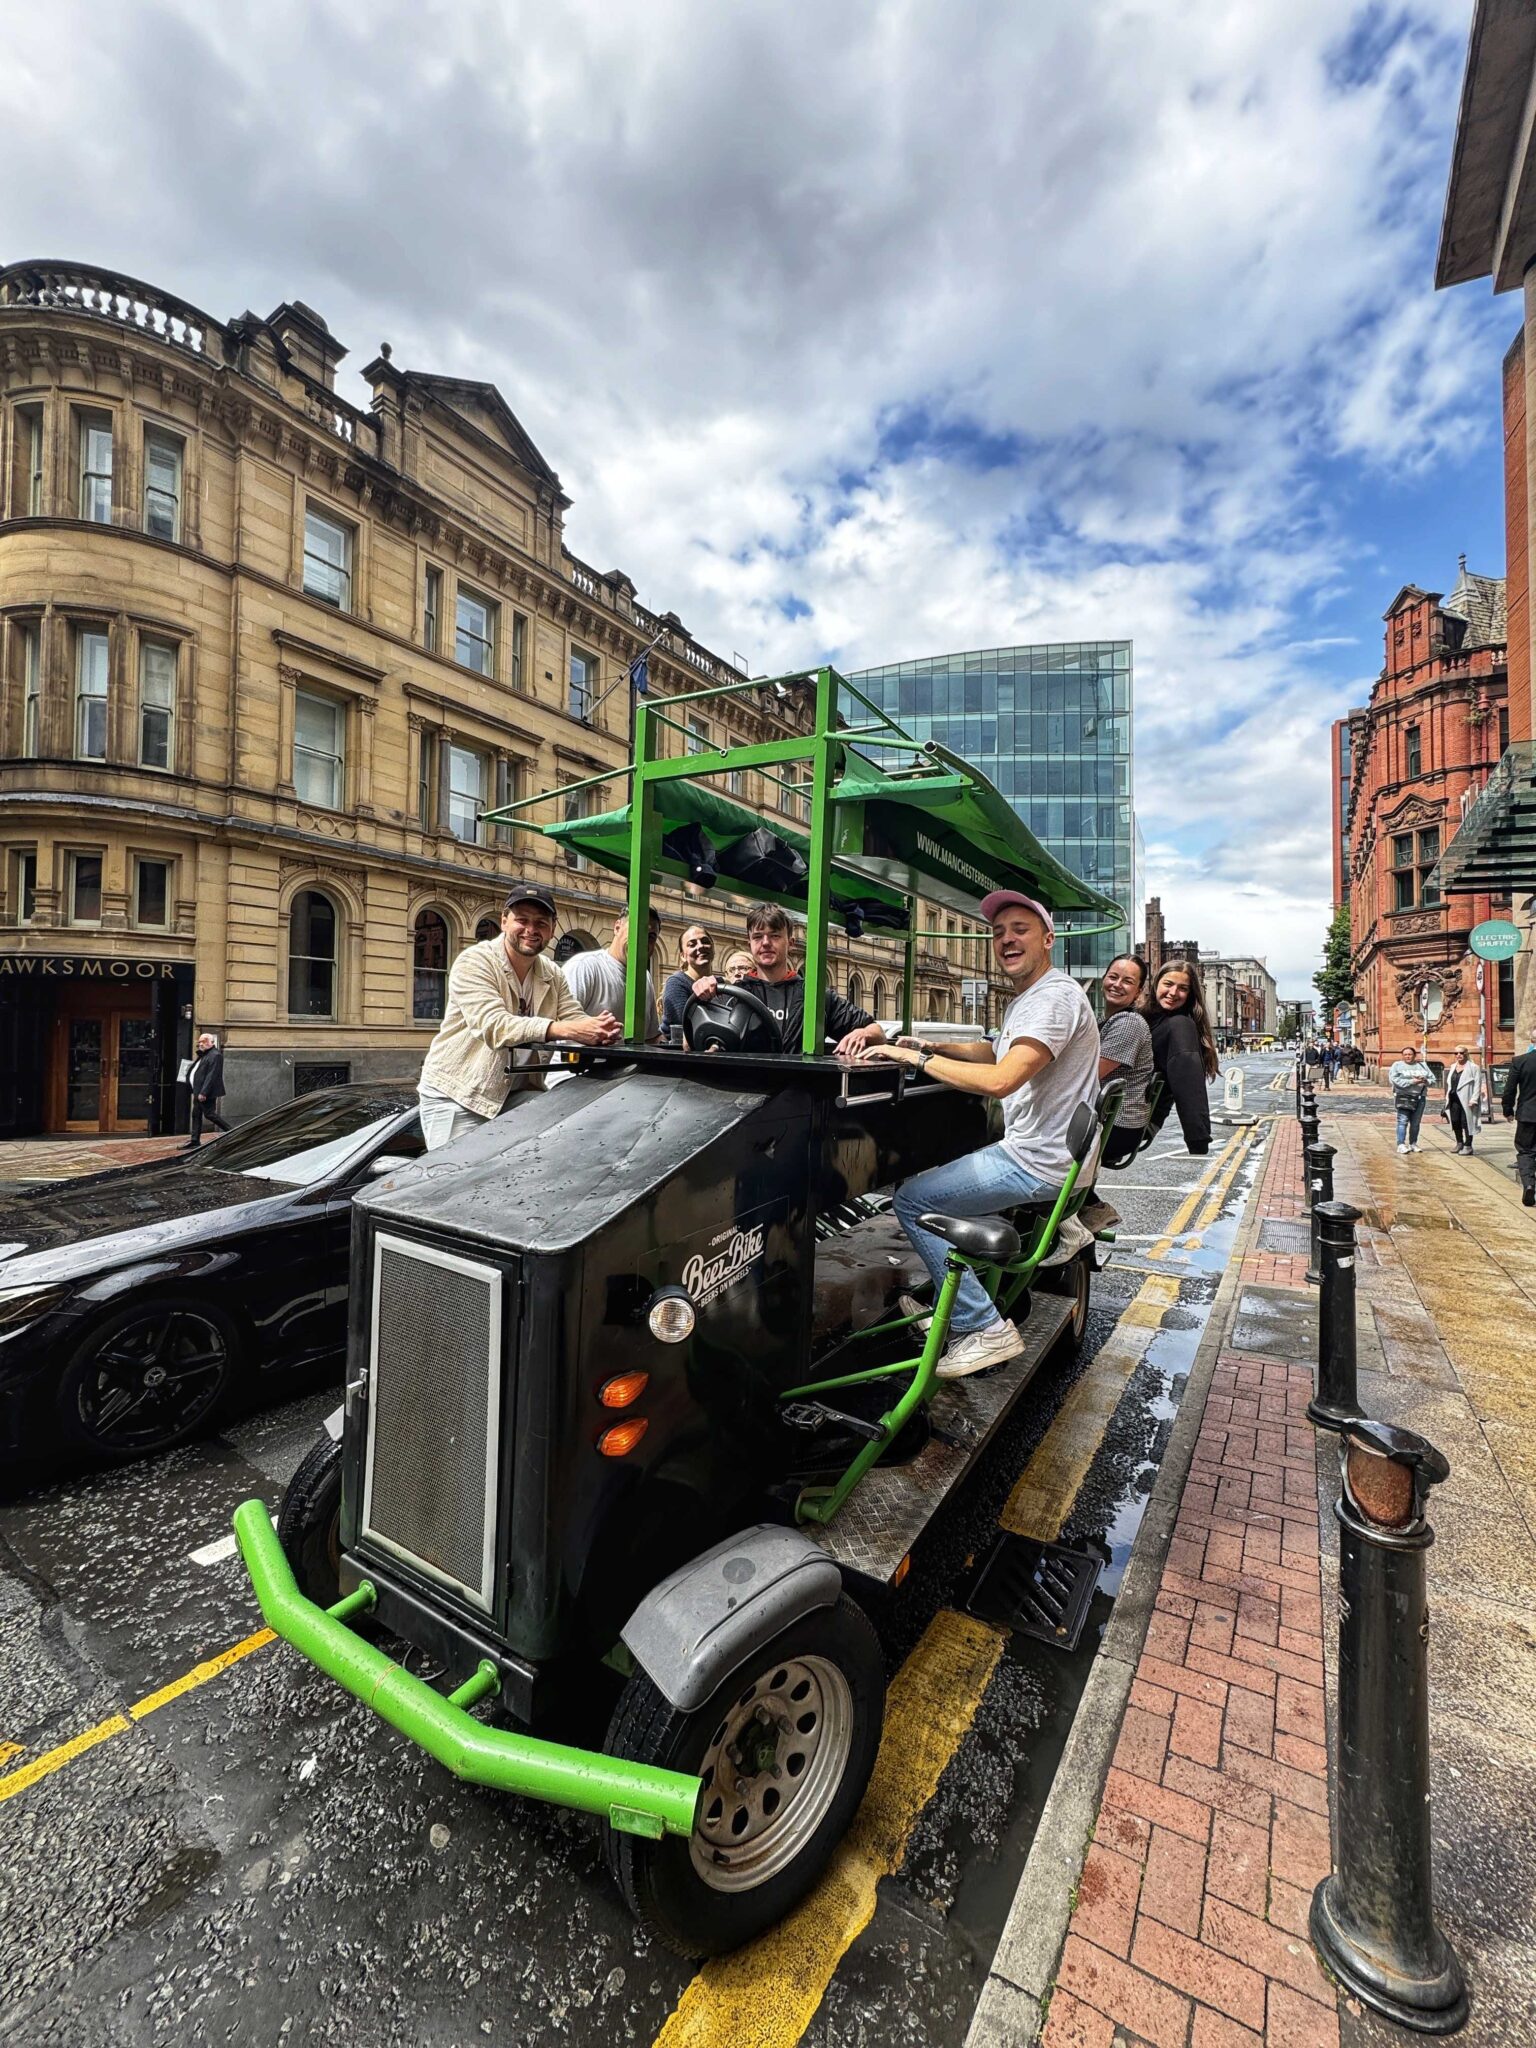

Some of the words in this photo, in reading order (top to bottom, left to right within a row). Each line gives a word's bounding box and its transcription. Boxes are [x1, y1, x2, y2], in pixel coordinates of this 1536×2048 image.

[711, 1225, 739, 1247] ORIGINAL
[681, 1254, 726, 1299] Beer
[727, 1229, 764, 1271] Bike
[700, 1287, 719, 1308] BEERS
[719, 1281, 728, 1293] ON
[728, 1266, 750, 1287] WHEELS
